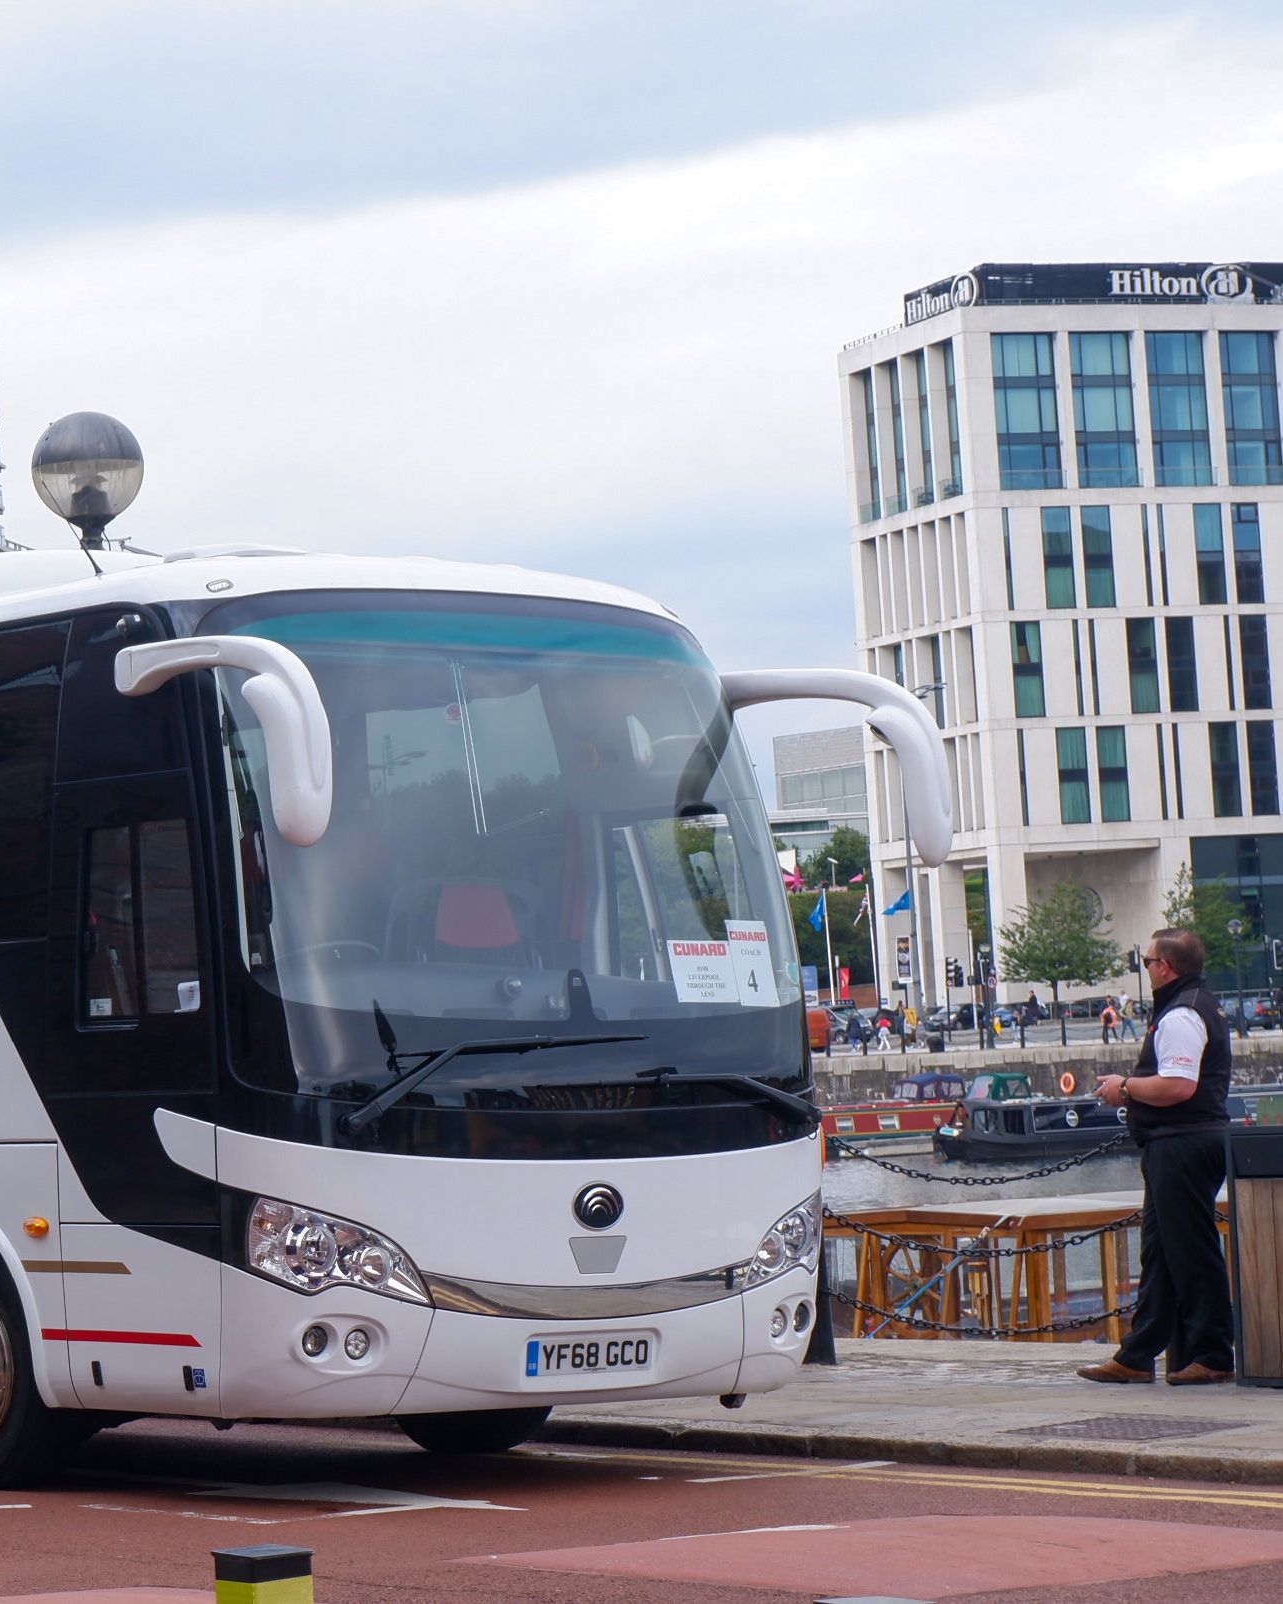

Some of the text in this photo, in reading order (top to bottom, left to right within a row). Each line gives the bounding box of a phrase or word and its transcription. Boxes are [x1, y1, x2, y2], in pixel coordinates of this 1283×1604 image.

[1109, 268, 1200, 296] Hilton
[906, 291, 950, 324] Hilton
[729, 931, 766, 941] CUNARD
[673, 943, 727, 956] CUNARD
[748, 969, 758, 992] 4
[542, 1339, 649, 1370] YF68 GCO
